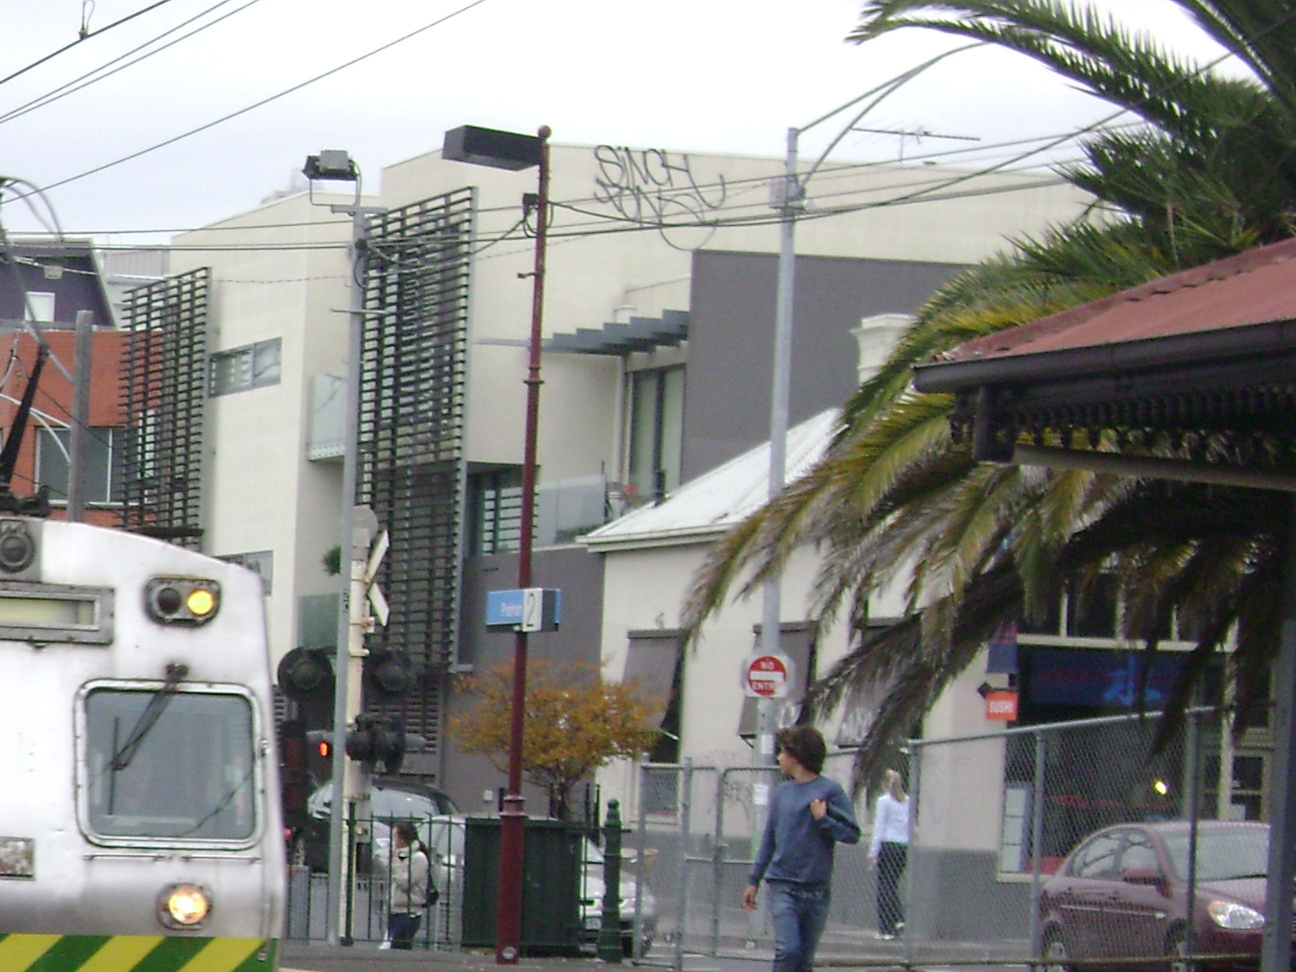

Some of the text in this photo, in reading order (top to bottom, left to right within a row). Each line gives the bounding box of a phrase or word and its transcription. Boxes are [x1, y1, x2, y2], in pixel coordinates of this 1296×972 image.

[526, 592, 535, 627] 2
[760, 660, 775, 670] NO
[752, 681, 782, 691] ENTR
[989, 700, 1014, 713] SUSHI
